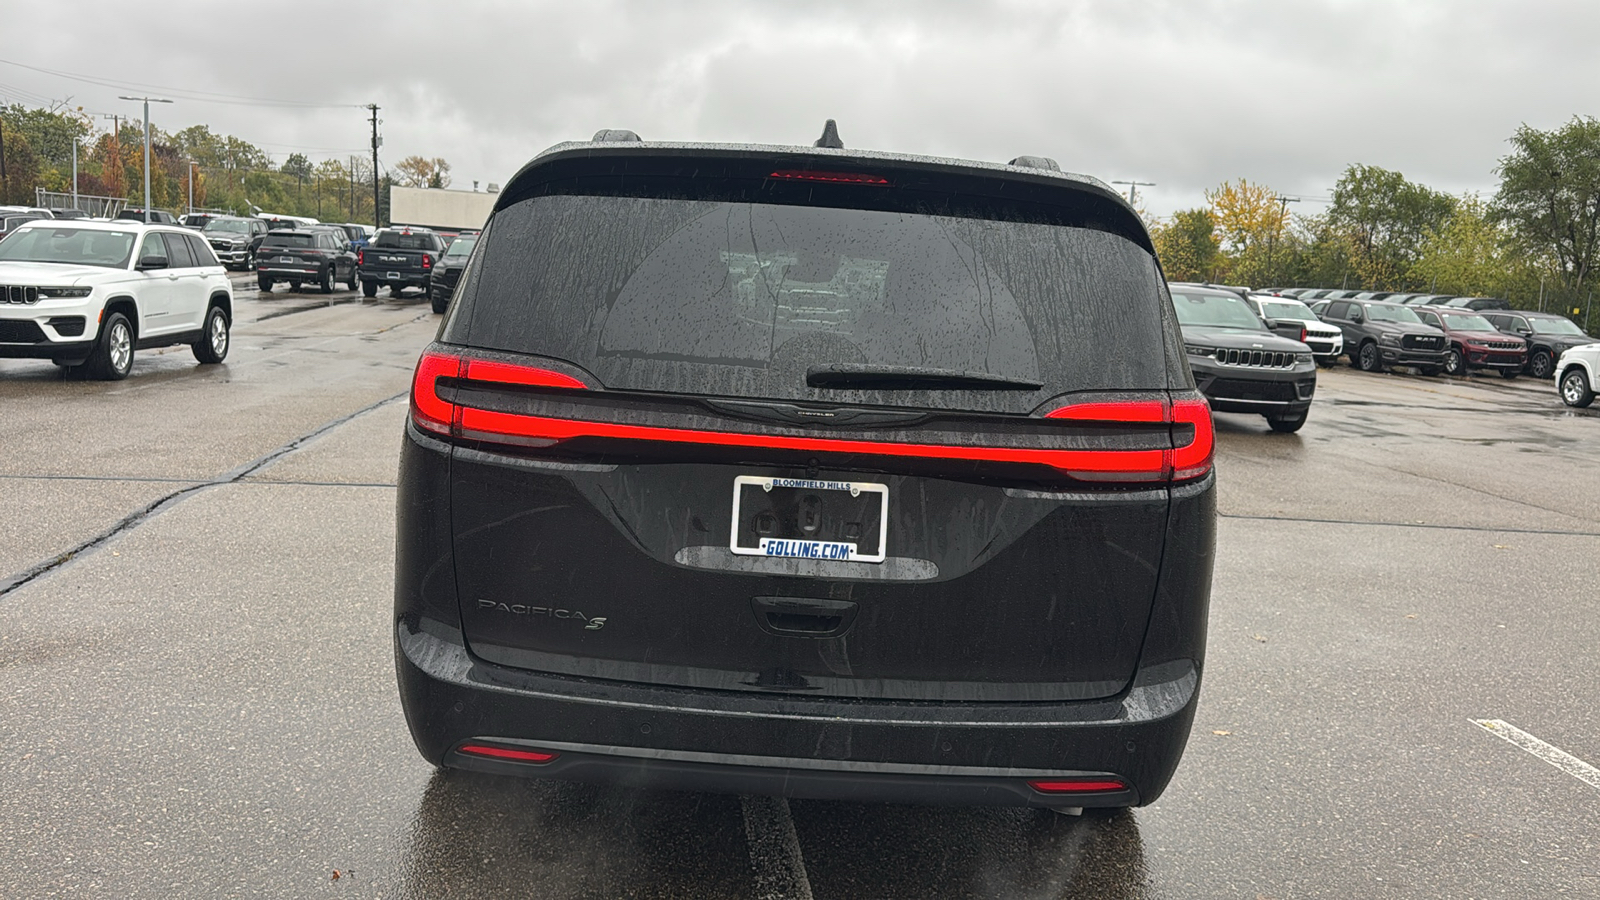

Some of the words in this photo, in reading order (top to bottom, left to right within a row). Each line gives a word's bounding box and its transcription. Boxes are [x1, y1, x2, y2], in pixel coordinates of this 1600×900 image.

[772, 478, 825, 489] BLOOMFIELD
[827, 481, 851, 491] HILLS
[766, 540, 850, 560] GOLLING.COM
[478, 599, 588, 621] PACIFICA
[585, 617, 607, 630] S
